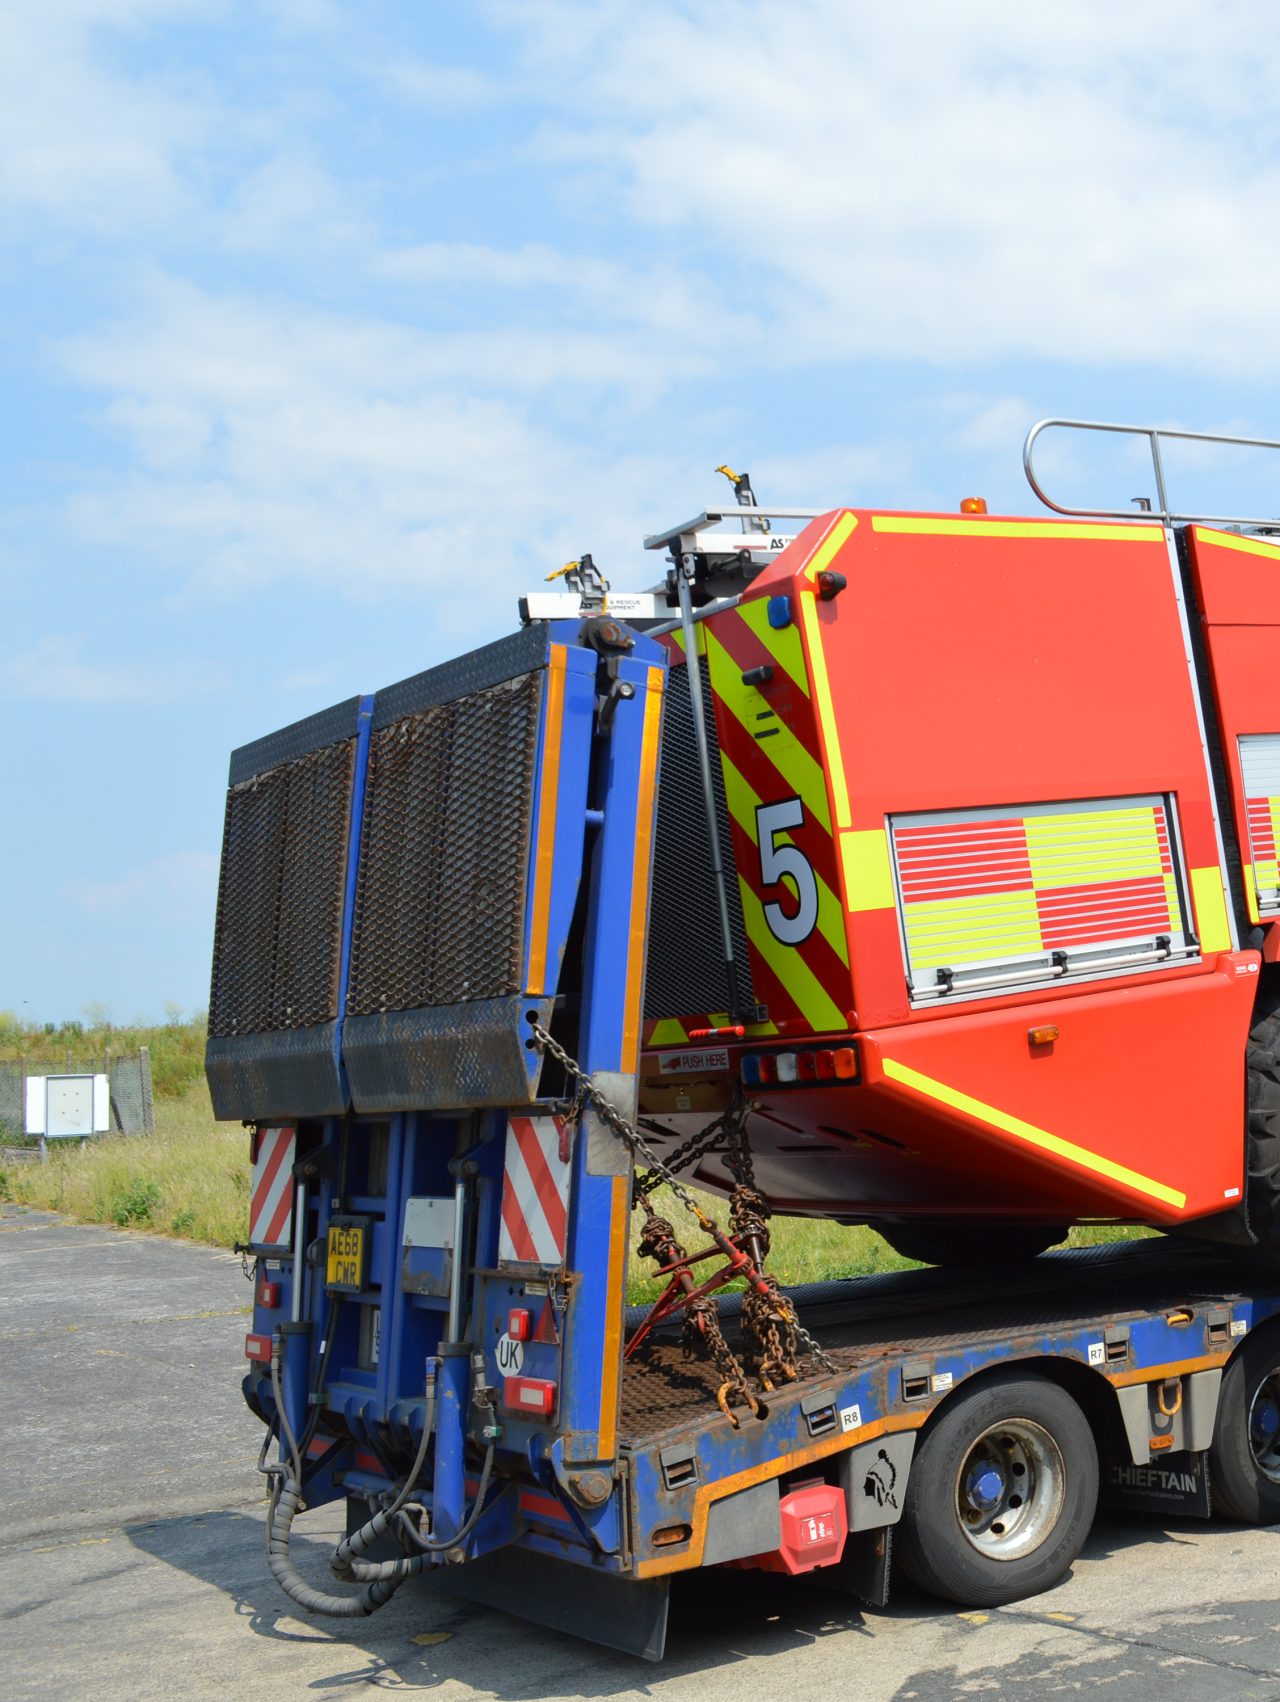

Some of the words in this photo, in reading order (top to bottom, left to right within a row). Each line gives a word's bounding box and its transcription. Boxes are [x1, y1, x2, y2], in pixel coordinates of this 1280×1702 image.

[754, 794, 820, 947] 5
[682, 1055, 704, 1069] PUSH
[705, 1053, 727, 1067] HERE
[331, 1231, 359, 1257] AE68
[500, 1341, 519, 1370] UK
[1090, 1349, 1102, 1360] R7
[843, 1411, 858, 1425] R8
